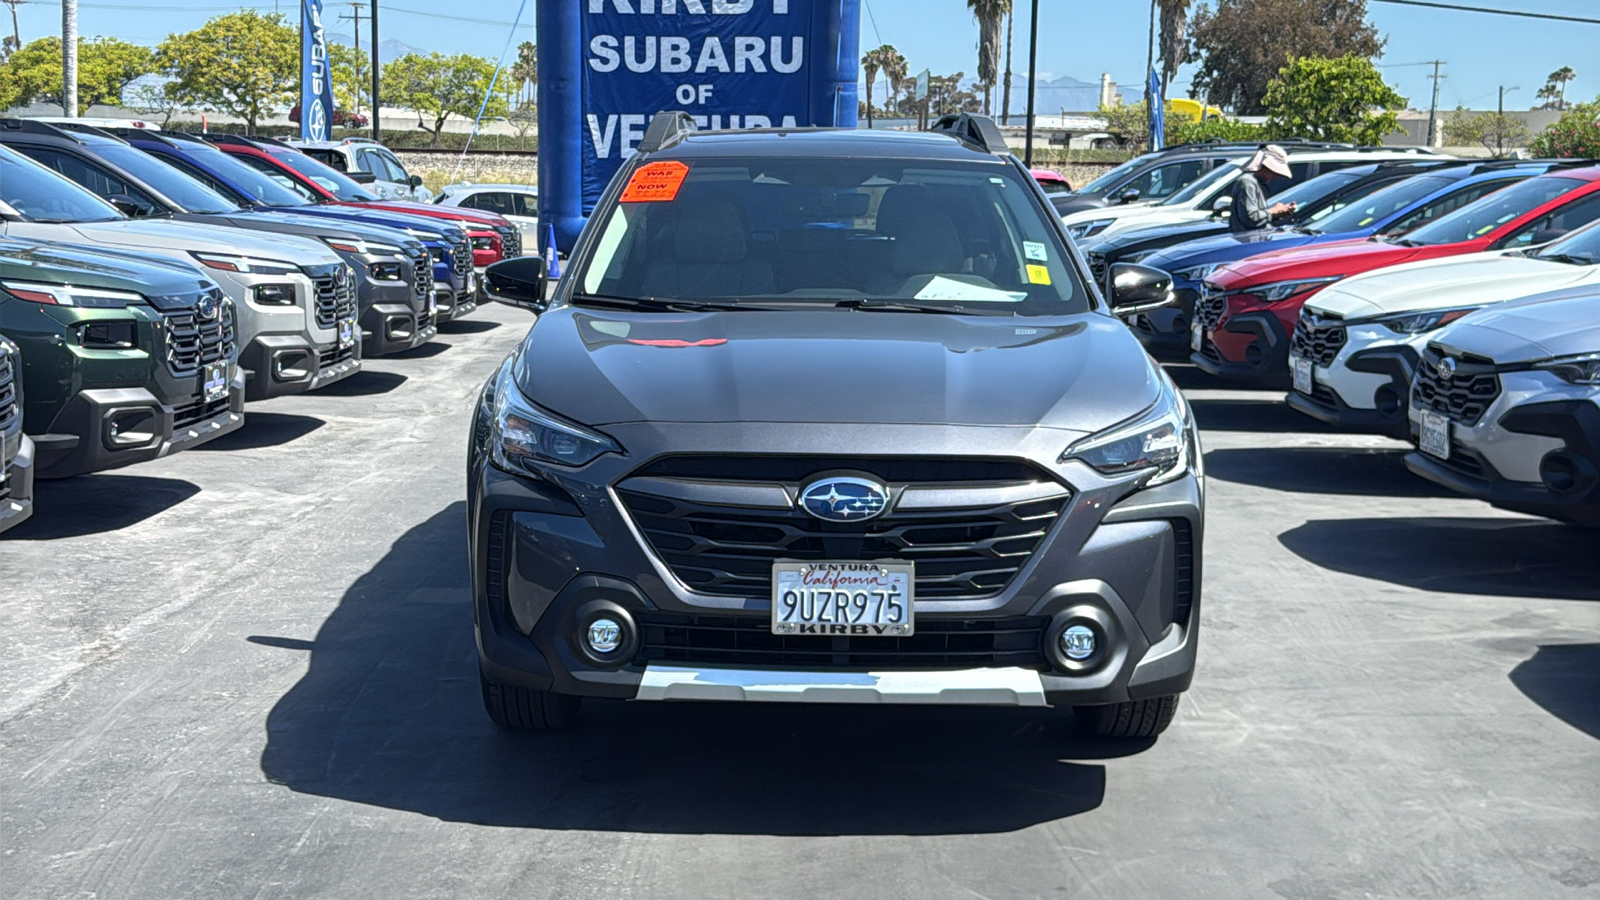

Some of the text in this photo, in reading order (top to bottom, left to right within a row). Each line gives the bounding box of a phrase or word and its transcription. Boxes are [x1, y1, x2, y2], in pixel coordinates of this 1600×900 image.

[588, 34, 804, 74] SUBARU
[675, 84, 714, 105] OF
[808, 563, 879, 571] VENTURA
[802, 571, 888, 589] California
[782, 590, 903, 624] 9UZR975
[799, 624, 889, 634] KIRBY
